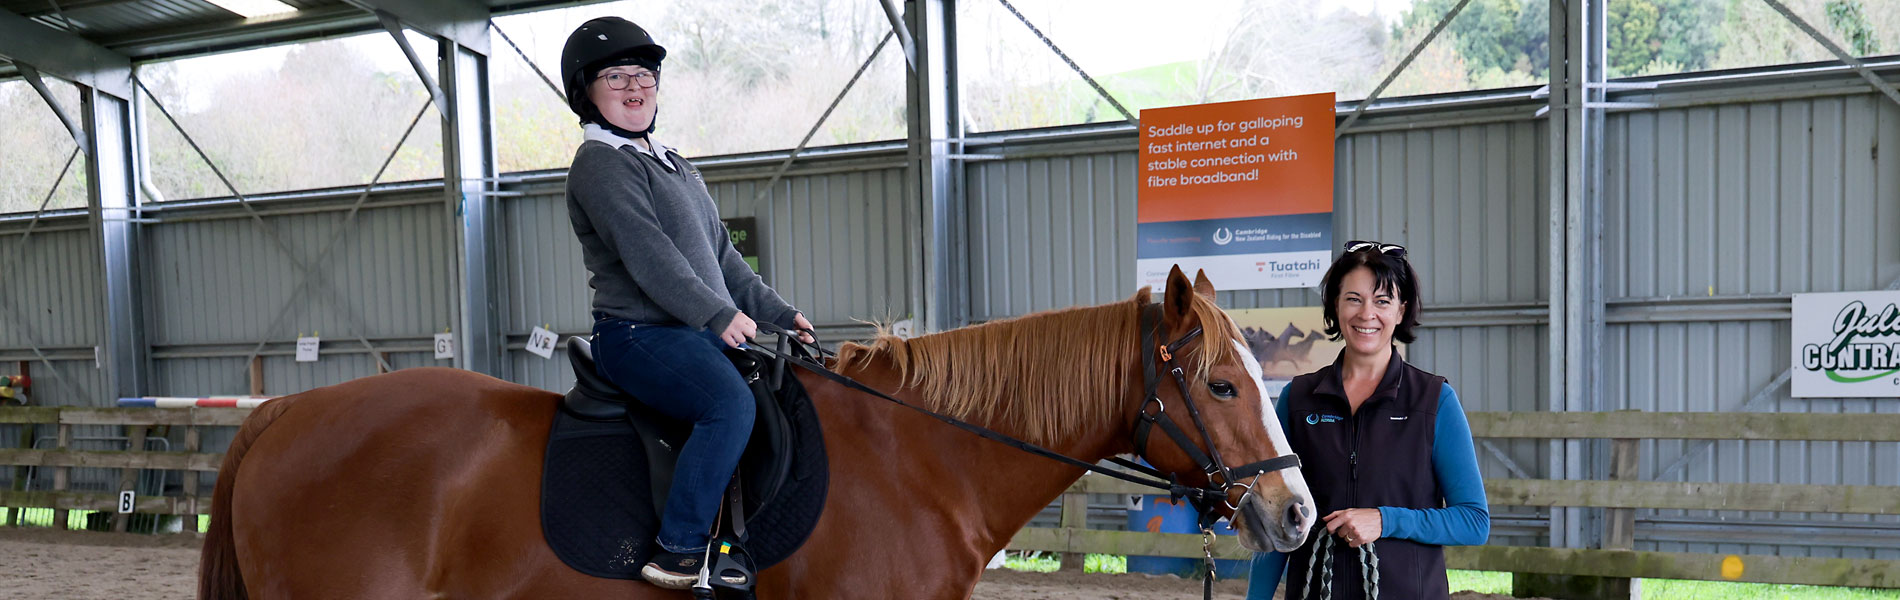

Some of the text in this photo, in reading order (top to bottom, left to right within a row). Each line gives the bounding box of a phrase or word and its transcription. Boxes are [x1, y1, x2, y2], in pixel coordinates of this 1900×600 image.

[1148, 114, 1304, 138] Saddle up for galloping
[1148, 134, 1270, 154] fast internet and a
[1147, 148, 1298, 171] stable connection with
[1147, 168, 1259, 187] fibre broadband!
[1235, 228, 1268, 236] Cambridge
[1269, 259, 1320, 272] Tuatahi
[436, 338, 447, 354] G
[530, 332, 543, 348] N
[122, 493, 131, 512] B
